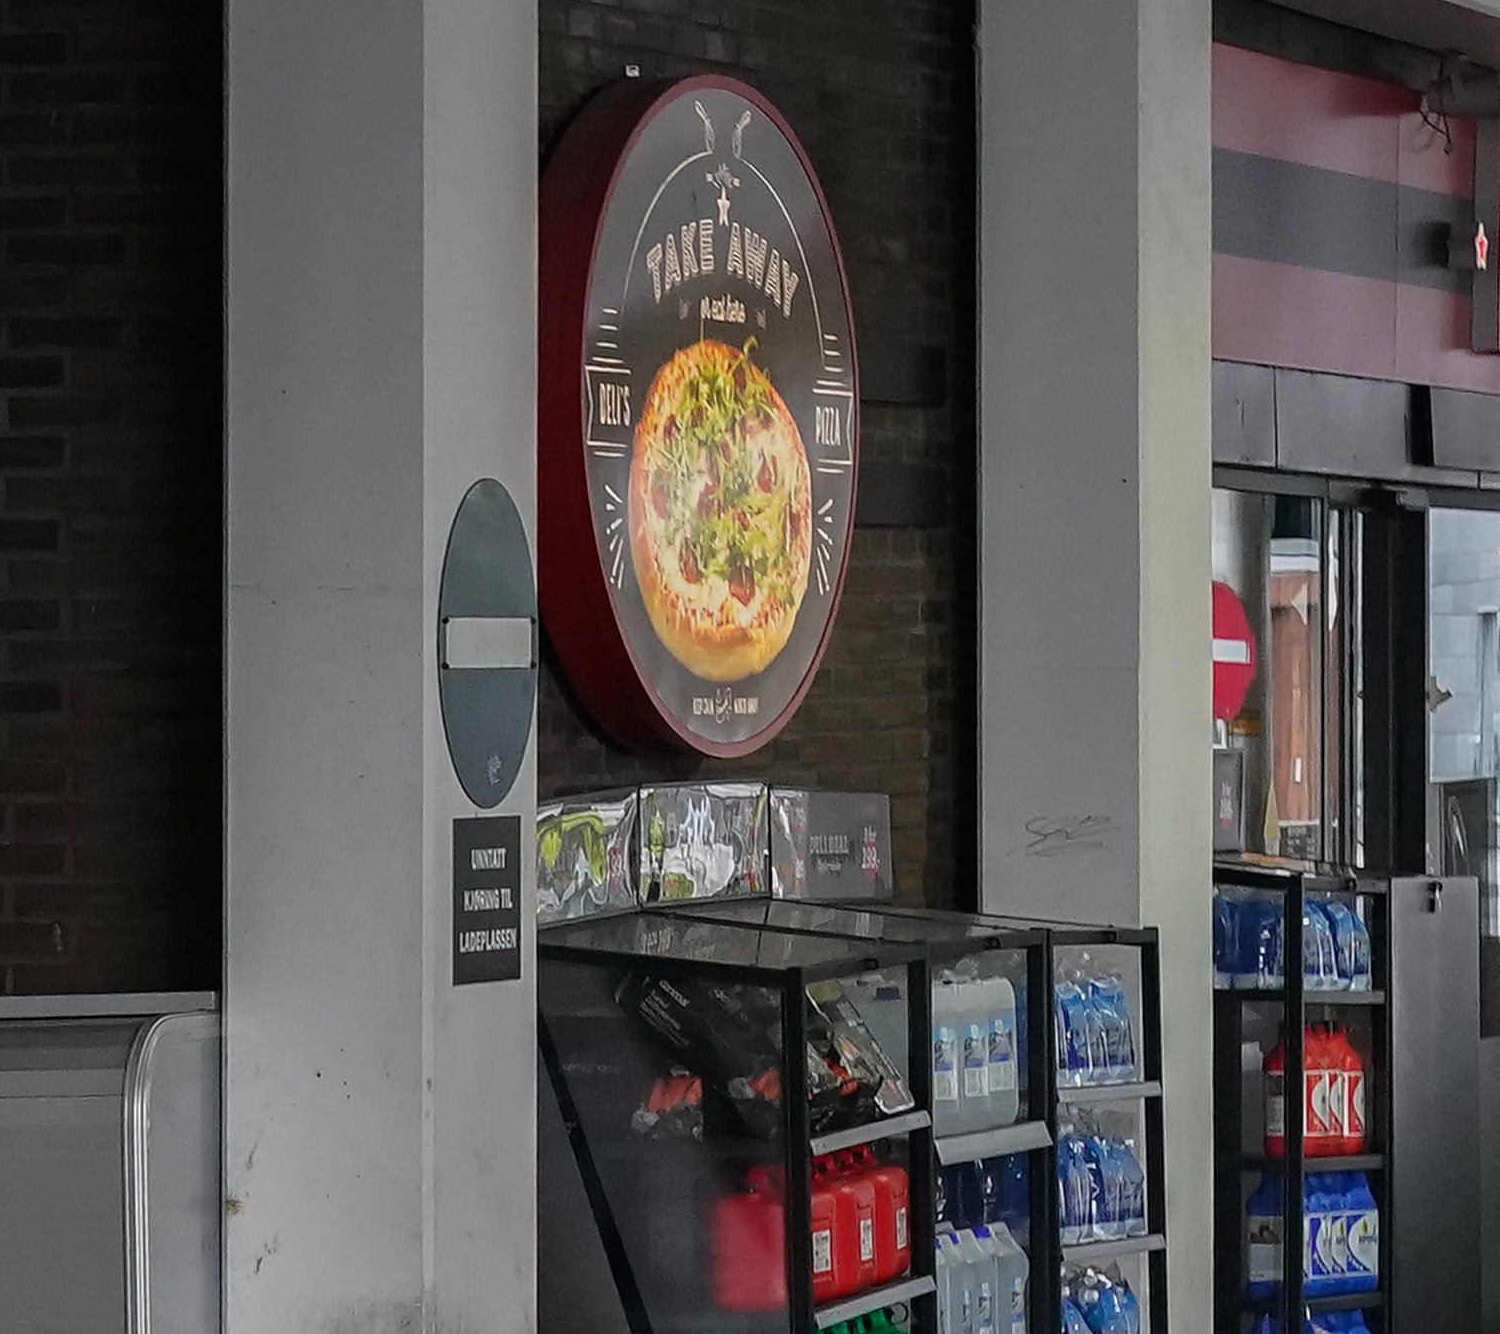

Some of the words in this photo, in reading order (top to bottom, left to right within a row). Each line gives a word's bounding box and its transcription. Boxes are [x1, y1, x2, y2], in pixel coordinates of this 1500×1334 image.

[646, 218, 715, 305] TAKE
[727, 221, 800, 319] AWAY
[599, 382, 632, 427] DELI'S
[815, 405, 841, 446] PIZZA
[471, 847, 507, 870] UNNTATT
[500, 887, 513, 910] TIL
[459, 928, 518, 954] LADEPLASSEN
